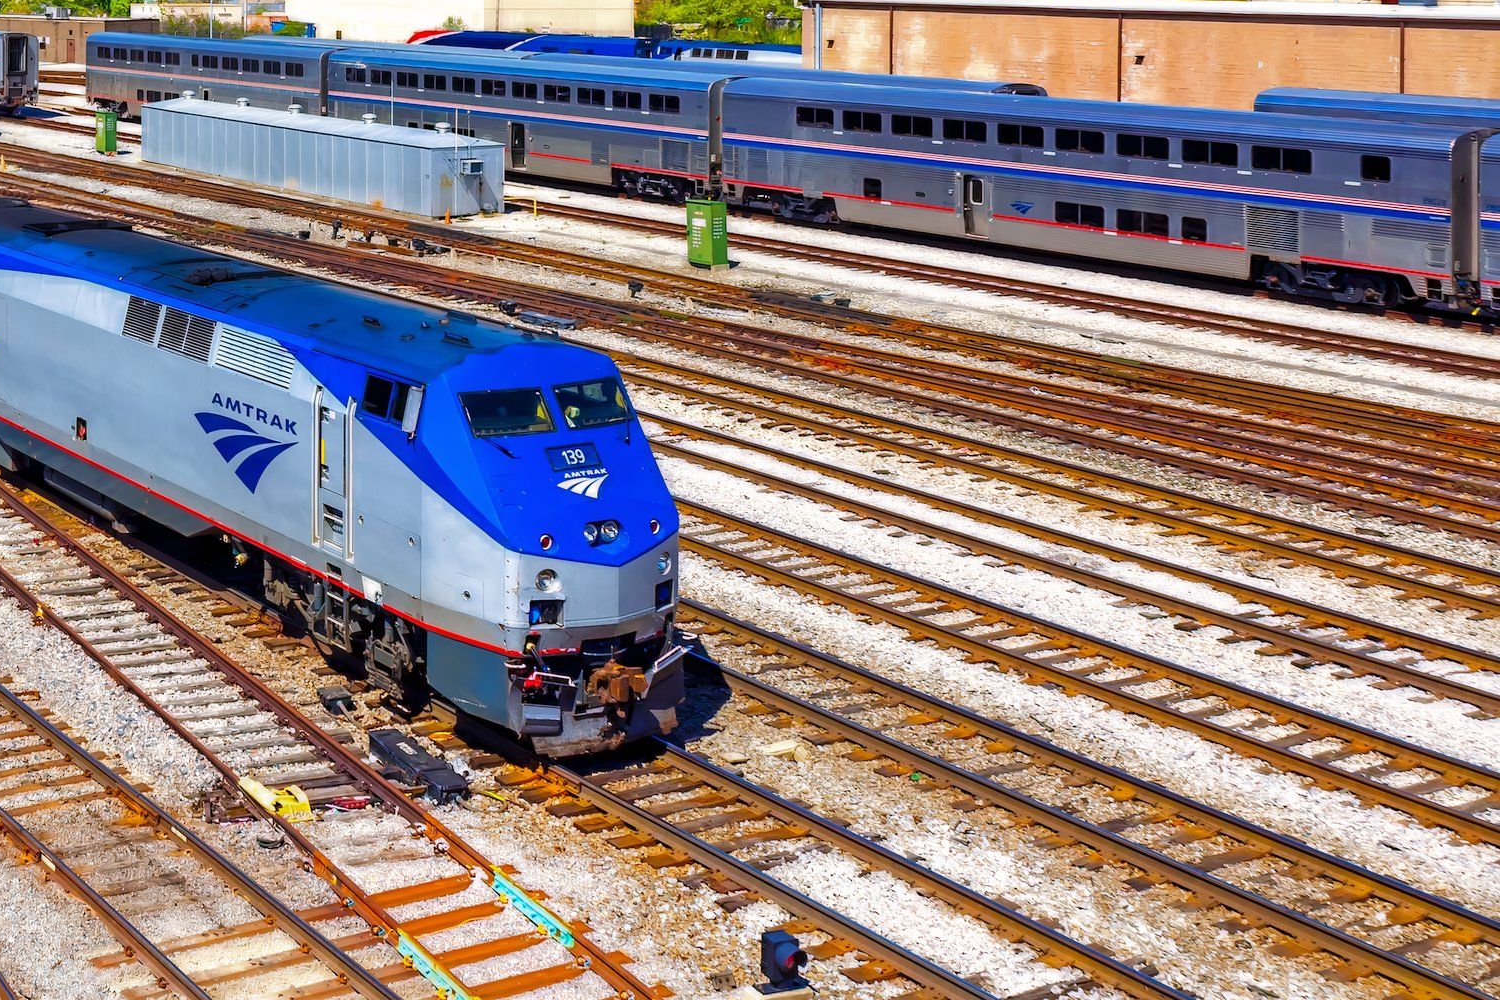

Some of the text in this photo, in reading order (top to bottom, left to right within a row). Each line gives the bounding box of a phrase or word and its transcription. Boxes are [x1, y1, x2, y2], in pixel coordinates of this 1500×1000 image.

[211, 392, 297, 436] AMTRAK
[561, 448, 586, 465] 139
[564, 467, 608, 479] AMTRAK
